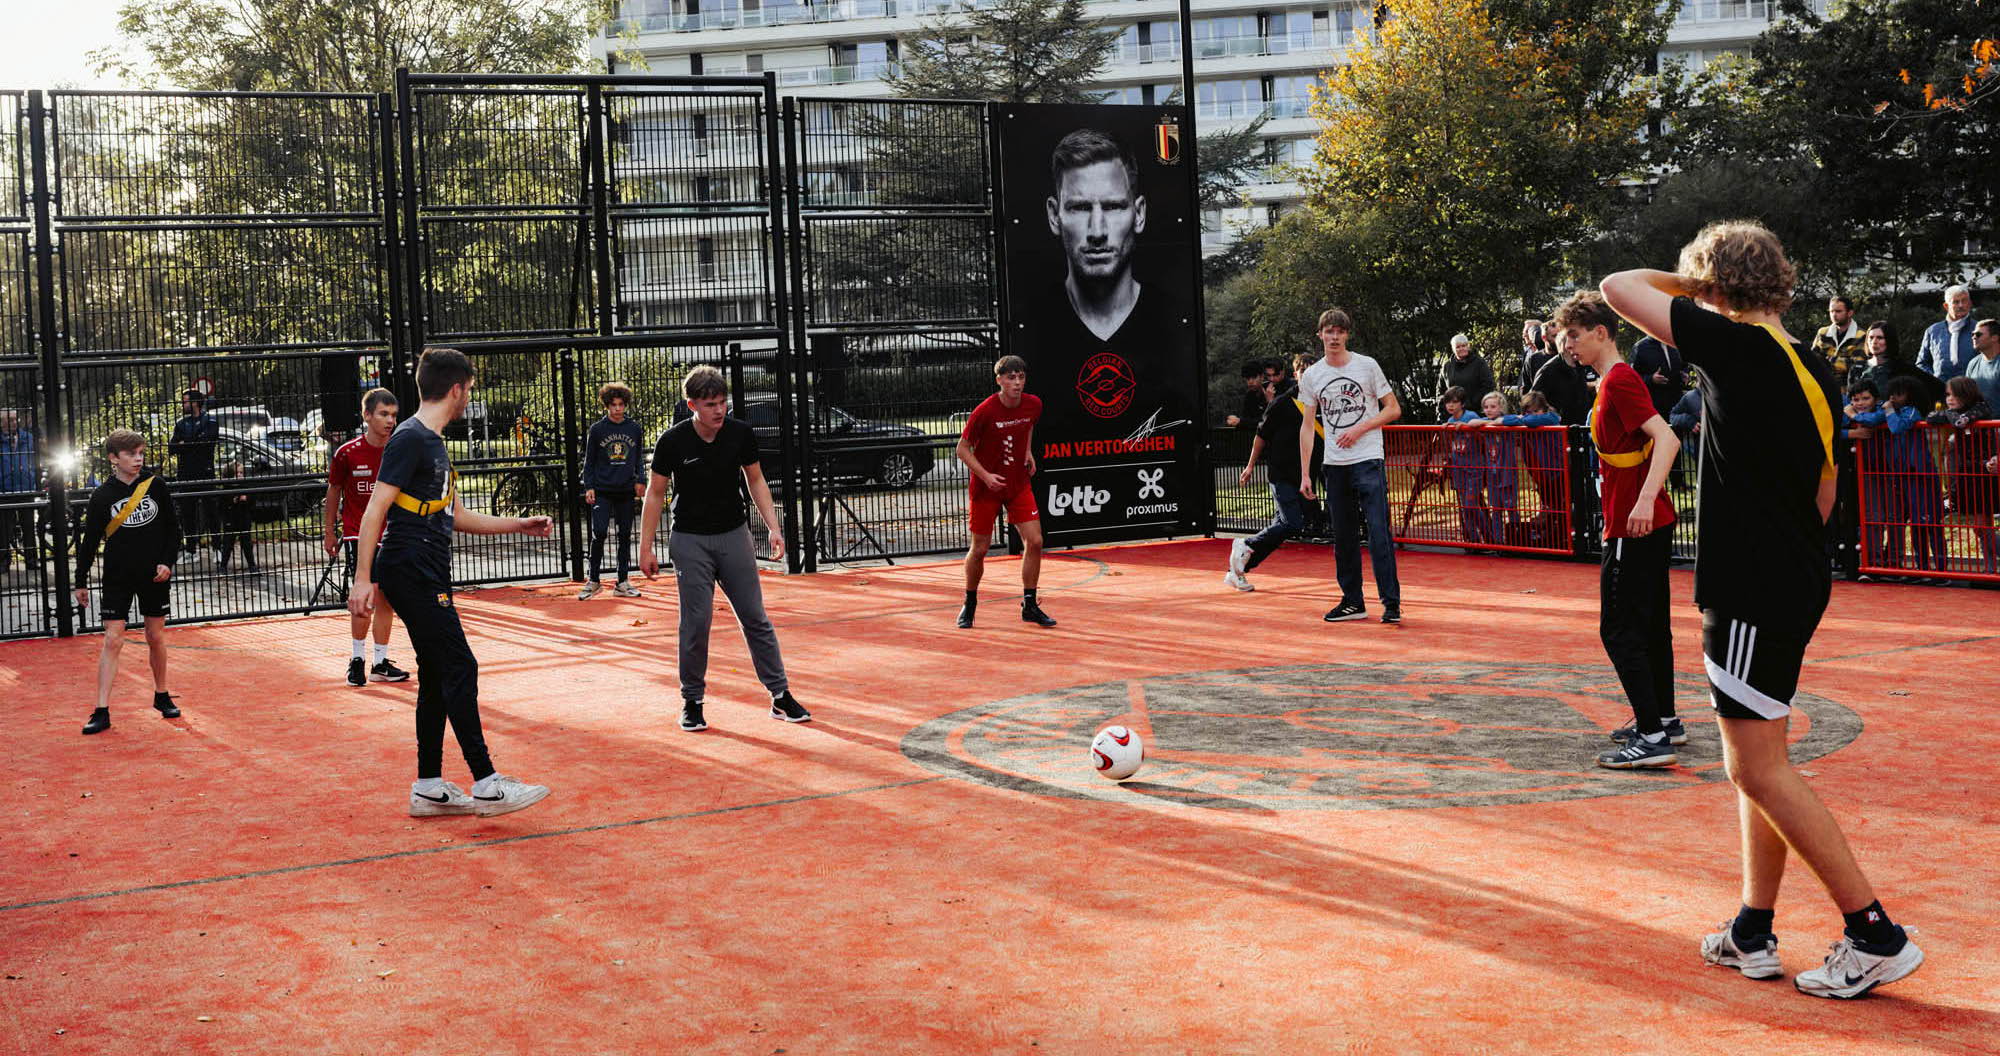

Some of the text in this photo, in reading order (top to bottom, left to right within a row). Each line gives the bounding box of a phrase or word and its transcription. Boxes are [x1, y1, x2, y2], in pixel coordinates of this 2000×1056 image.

[1087, 356, 1123, 370] BELGIAN
[1100, 395, 1130, 416] COURTS
[1043, 436, 1175, 459] JAN VERTONGHEN
[1126, 502, 1179, 519] proximus
